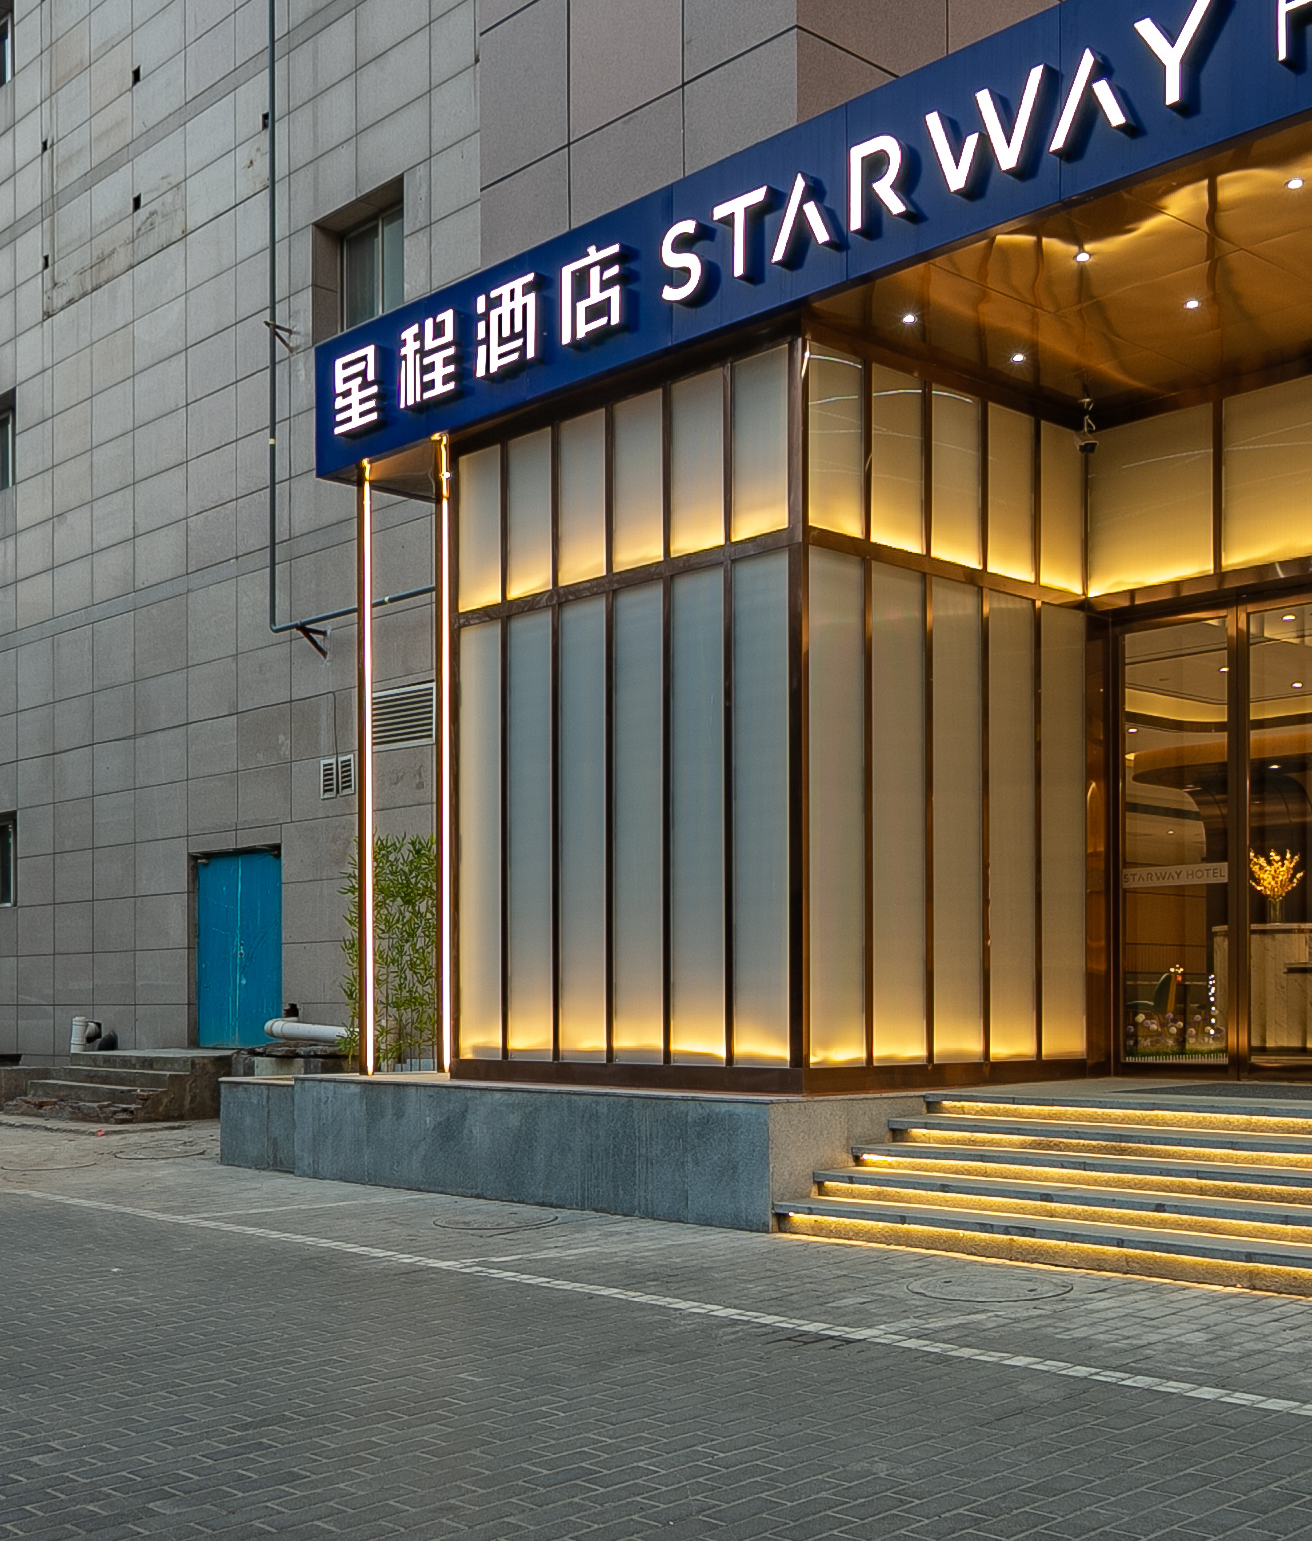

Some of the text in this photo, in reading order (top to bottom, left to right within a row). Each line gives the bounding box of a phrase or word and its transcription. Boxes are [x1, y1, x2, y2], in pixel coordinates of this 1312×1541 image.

[332, 243, 621, 438] 星程酒店
[1123, 867, 1226, 883] STARWAY HOTEL
